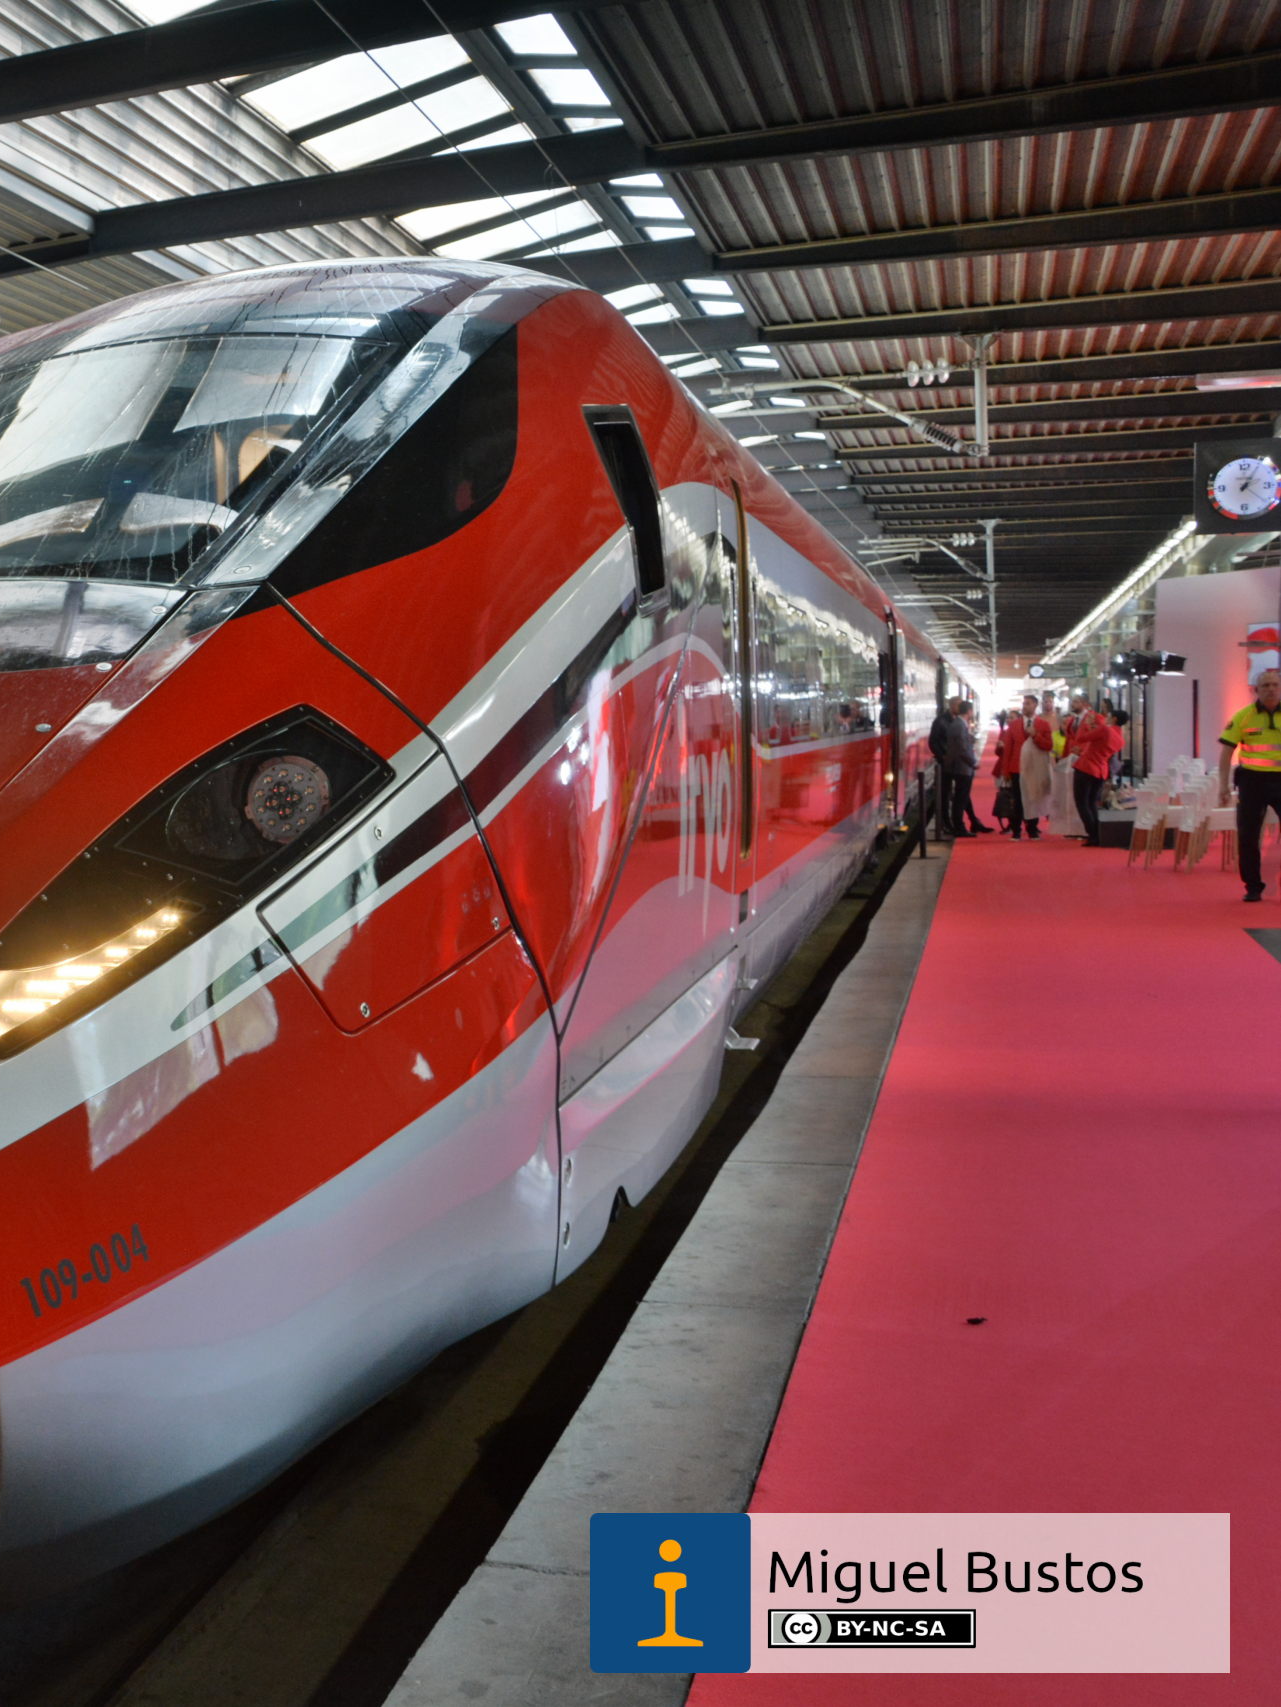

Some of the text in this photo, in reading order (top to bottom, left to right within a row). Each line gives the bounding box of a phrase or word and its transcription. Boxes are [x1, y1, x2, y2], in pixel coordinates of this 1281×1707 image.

[1218, 485, 1226, 493] 9
[1263, 481, 1272, 490] 3
[1240, 503, 1249, 511] 6
[677, 696, 732, 938] iryo
[21, 1223, 149, 1318] 109-004
